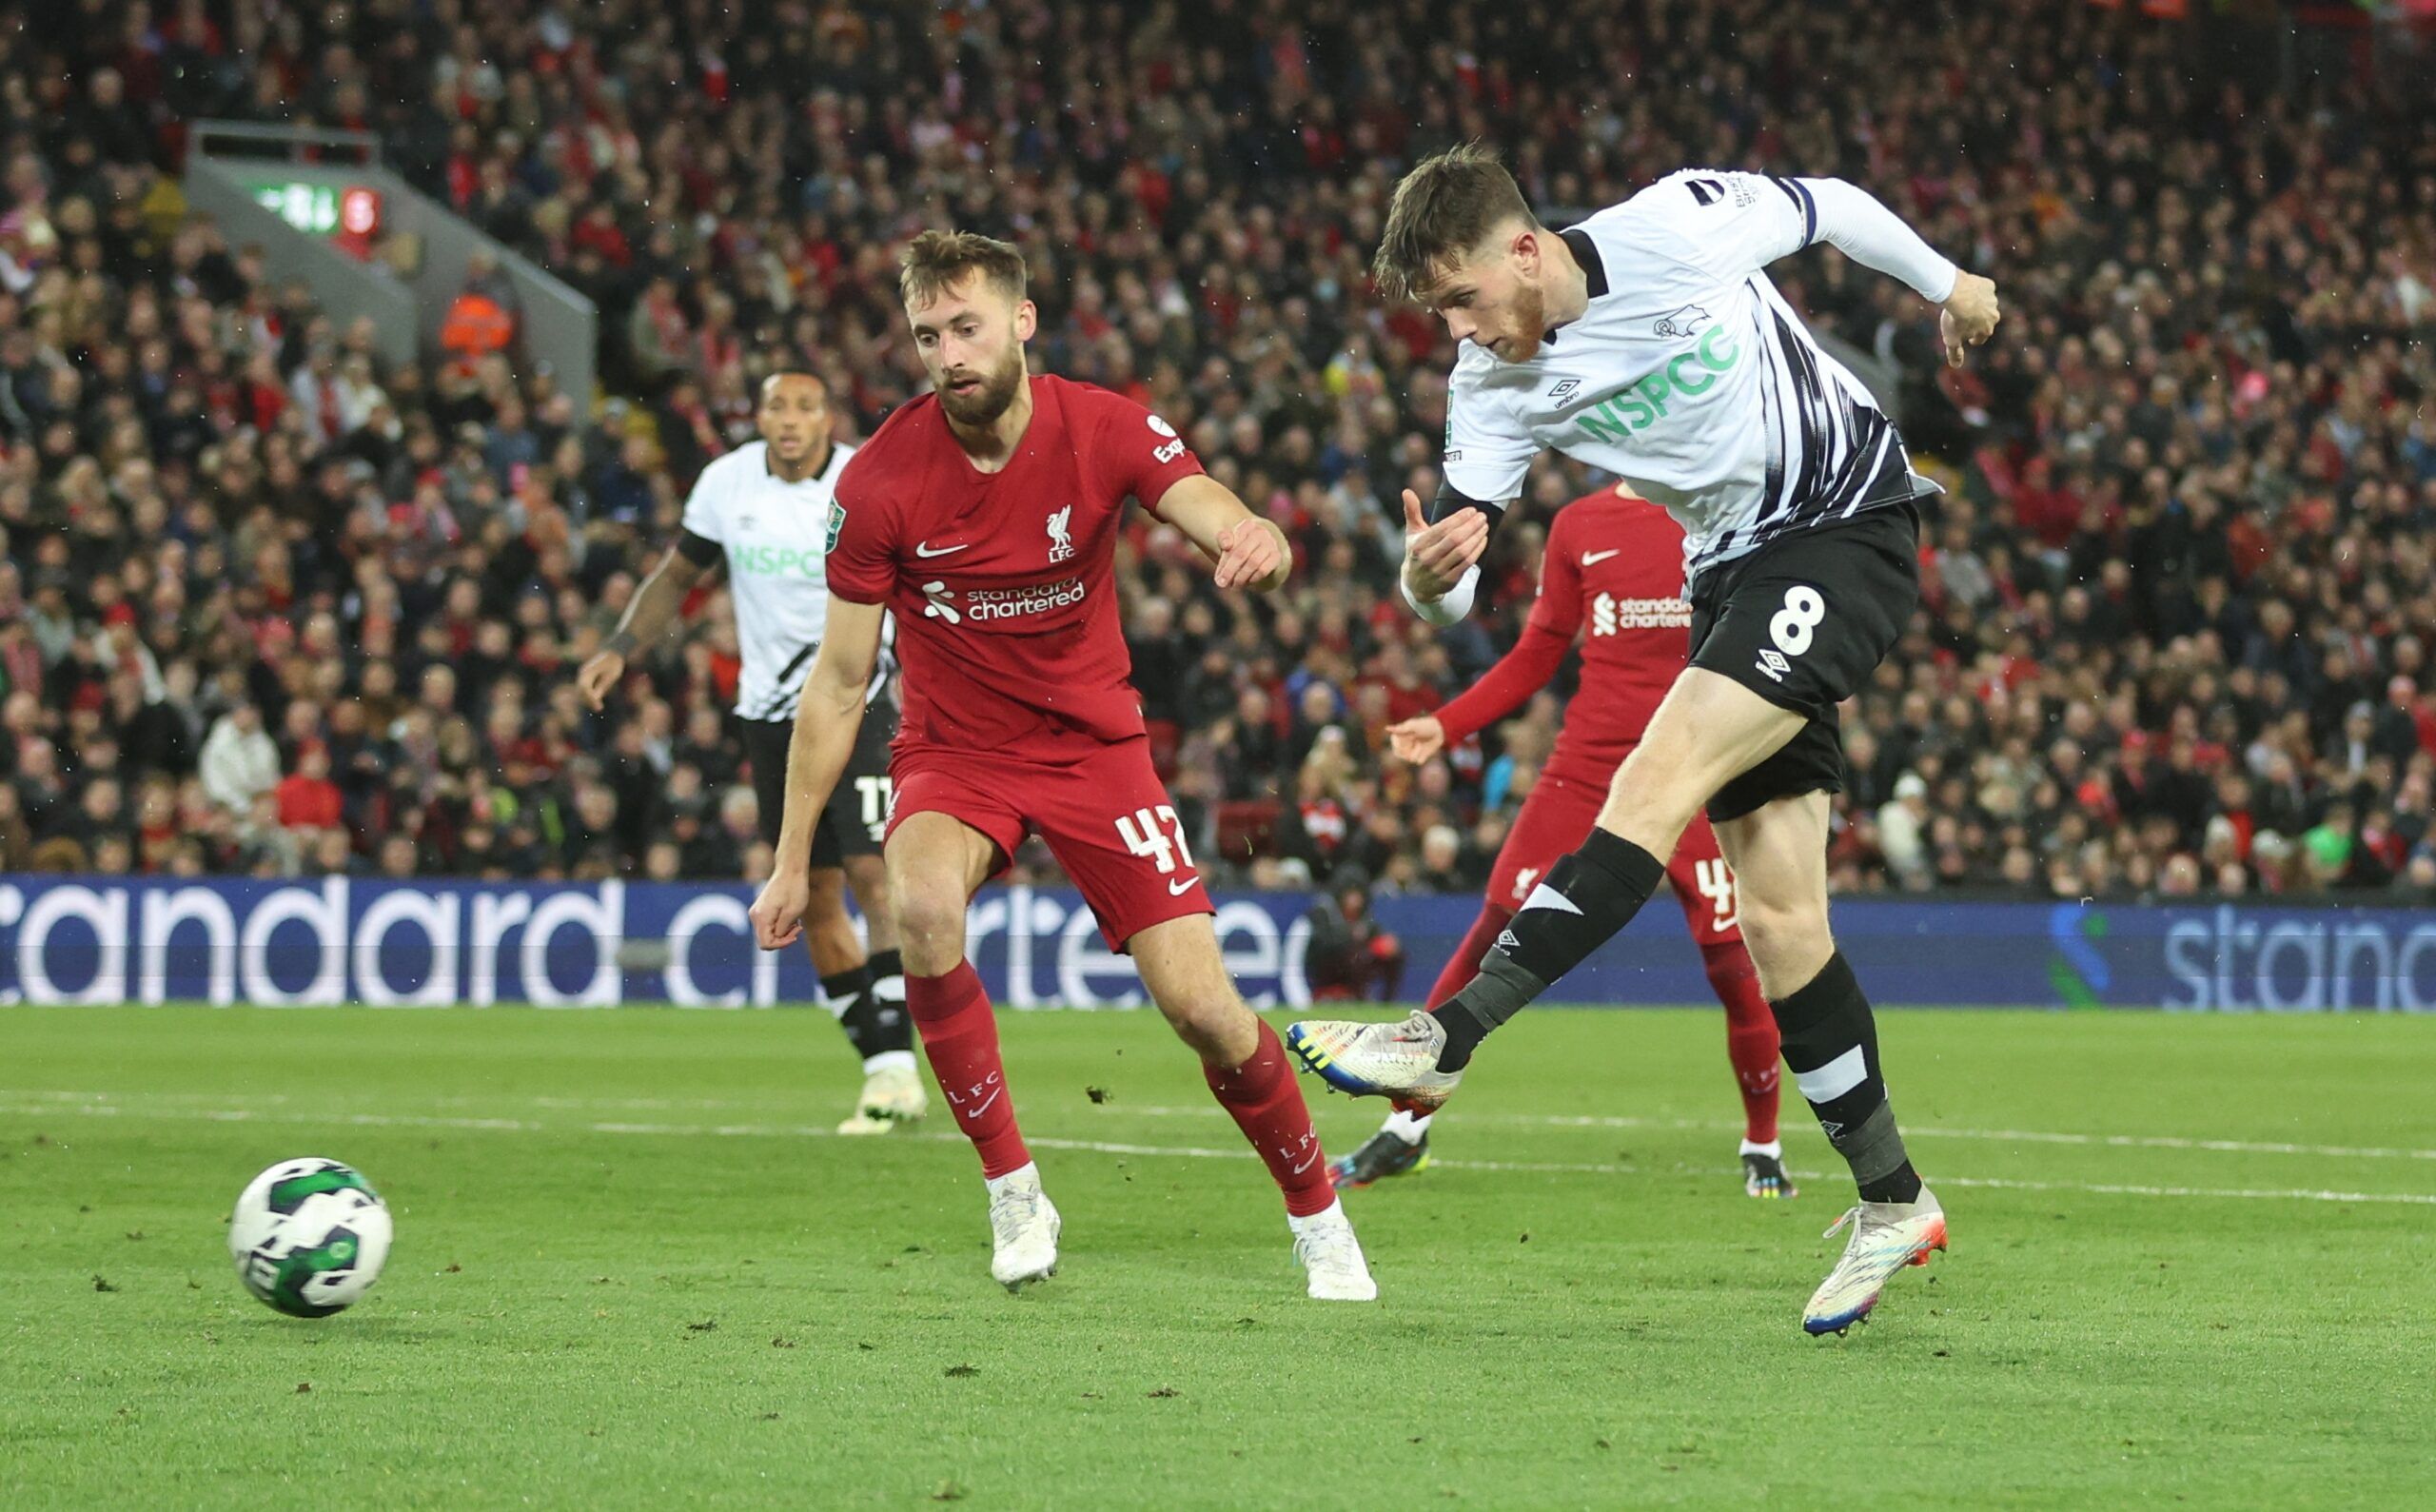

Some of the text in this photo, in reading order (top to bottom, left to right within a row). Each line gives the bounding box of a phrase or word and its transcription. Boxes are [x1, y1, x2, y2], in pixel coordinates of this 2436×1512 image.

[1554, 391, 1580, 409] umbro
[1576, 324, 1739, 443] NSPCC
[1152, 437, 1186, 463] Exp
[734, 542, 825, 579] NSPC
[1049, 548, 1075, 563] LFC
[967, 576, 1077, 602] standard
[968, 581, 1086, 620] chartered
[1619, 613, 1691, 628] chartere
[1769, 585, 1825, 657] 8
[1755, 660, 1783, 683] umbro
[855, 776, 893, 825] 11
[1113, 805, 1195, 874] 47
[948, 1070, 999, 1104] LFC
